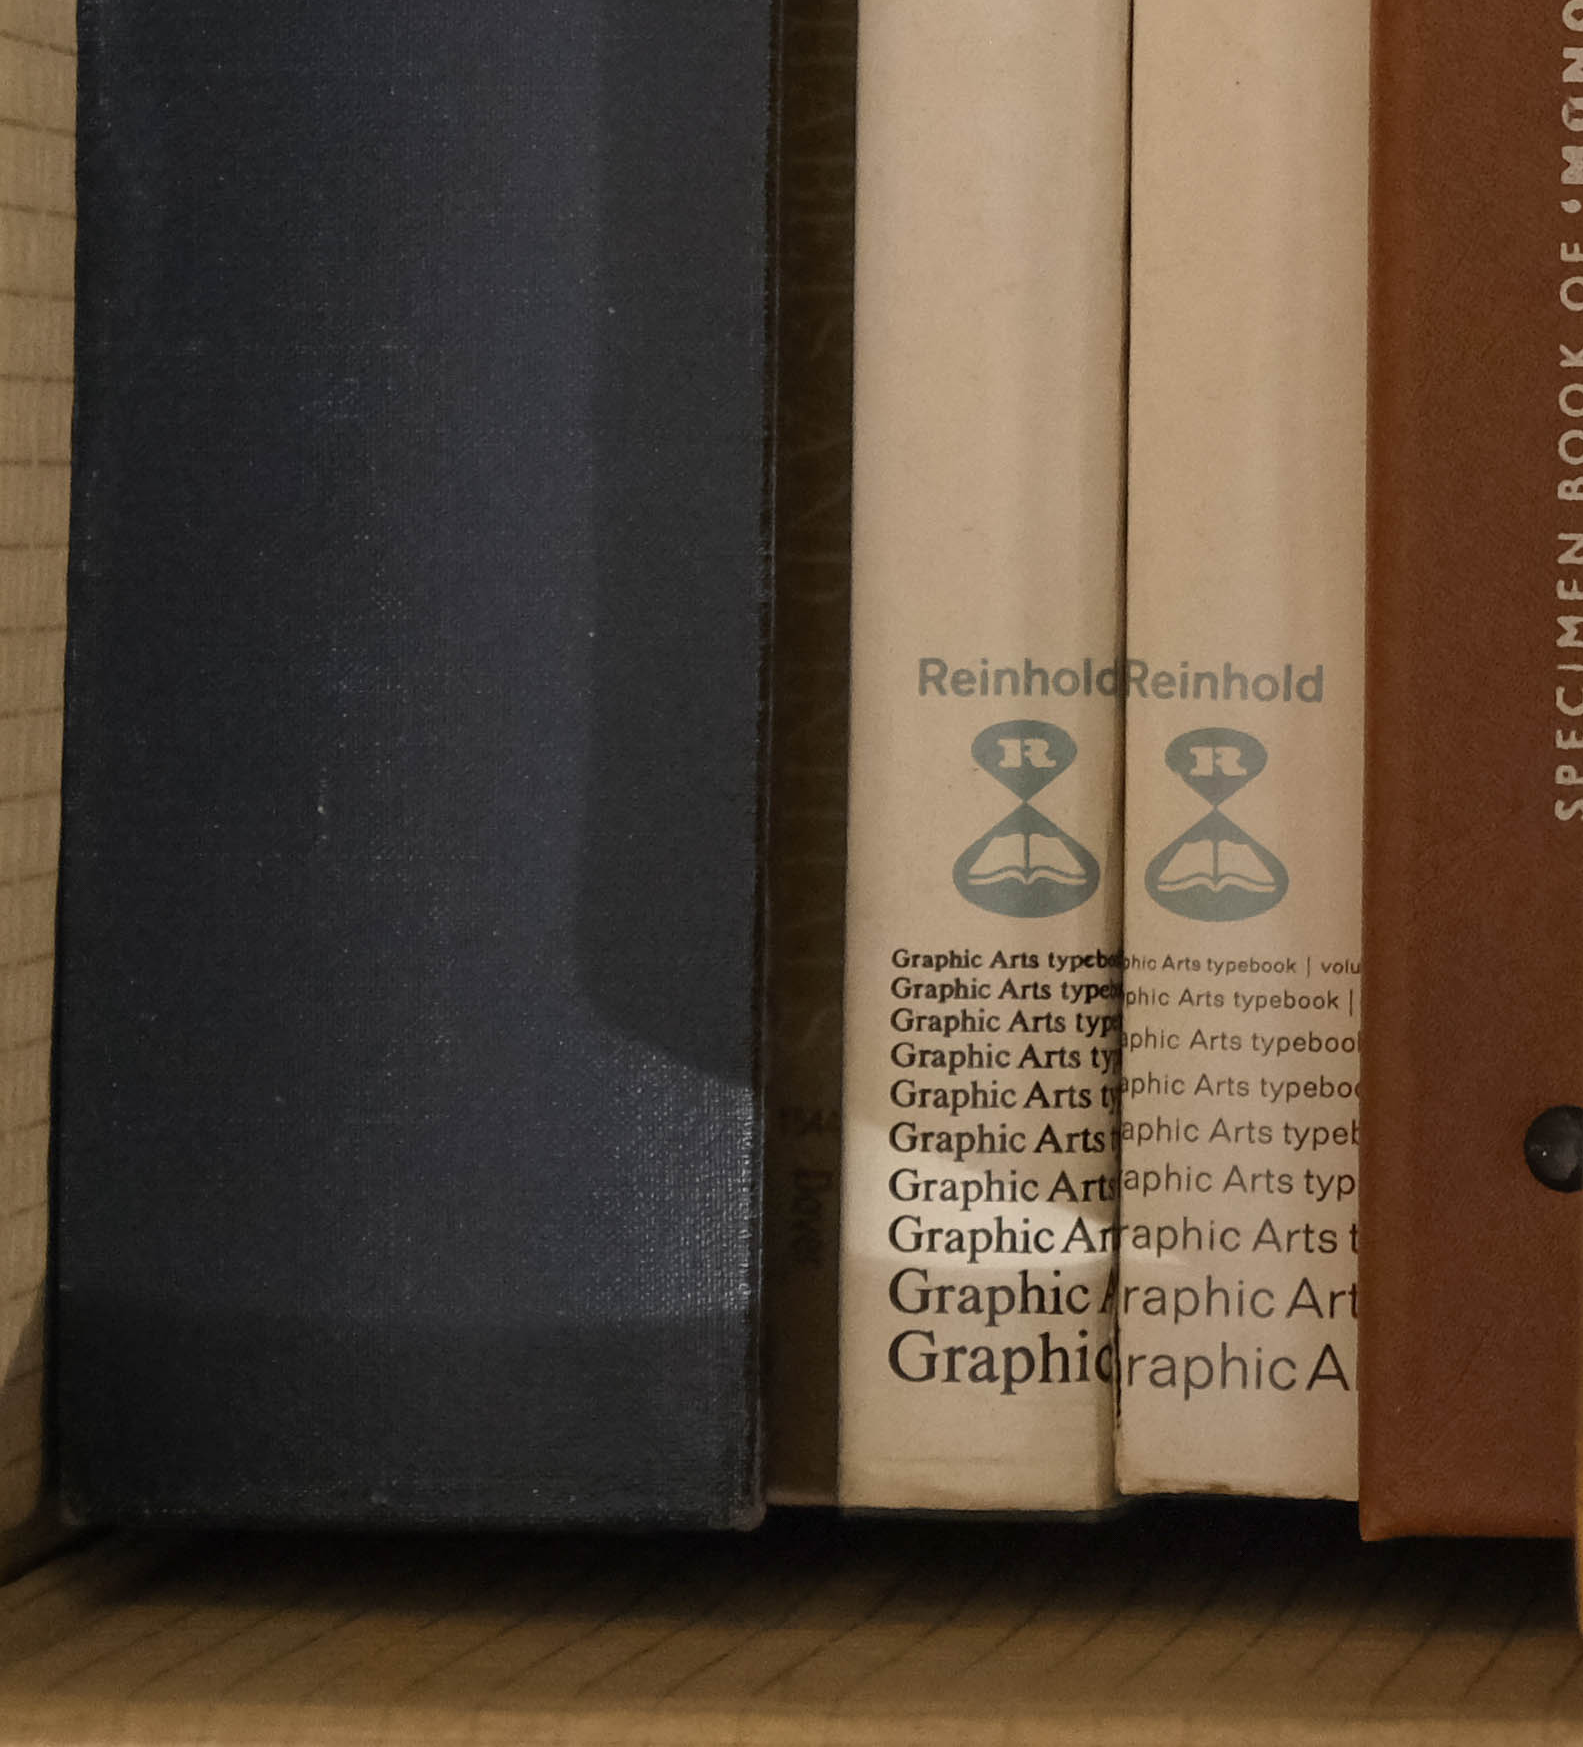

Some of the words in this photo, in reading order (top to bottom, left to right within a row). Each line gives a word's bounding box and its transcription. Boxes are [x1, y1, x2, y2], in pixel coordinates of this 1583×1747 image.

[918, 657, 1118, 698] Reinhold
[1125, 661, 1325, 703] Reinhold
[892, 948, 983, 973] Graphic
[988, 950, 1040, 970] Arts
[1161, 954, 1201, 972] Arts
[1207, 956, 1297, 977] typebook
[890, 976, 992, 1004] Graphic
[997, 977, 1052, 1001] Arts
[1177, 988, 1226, 1009] Arts
[1233, 989, 1341, 1013] typebook
[890, 1007, 1001, 1038] Graphic
[1006, 1009, 1067, 1033] Arts
[890, 1041, 1011, 1075] Graphic
[1016, 1043, 1082, 1070] Arts
[1188, 1028, 1243, 1052] Arts
[1251, 1031, 1361, 1058] typeboo
[889, 1078, 1017, 1117] Graphic
[1022, 1080, 1092, 1109] Arts
[1193, 1073, 1251, 1098] Arts
[888, 1121, 1026, 1163] Graphic
[1033, 1123, 1106, 1154] Arts
[1207, 1117, 1274, 1146] Arts
[888, 1167, 1040, 1212] Graphic
[1045, 1169, 1119, 1203] Arts
[1120, 1162, 1213, 1198] aphic
[1221, 1164, 1294, 1194] Arts
[1303, 1169, 1356, 1203] typ
[888, 1214, 1055, 1265] Graphic
[1251, 1217, 1339, 1254] Arts
[888, 1267, 1091, 1328] Graphic
[1123, 1274, 1276, 1325] raphic
[1285, 1276, 1359, 1319] Art
[887, 1329, 1114, 1396] Graphic
[1127, 1340, 1297, 1402] raphic
